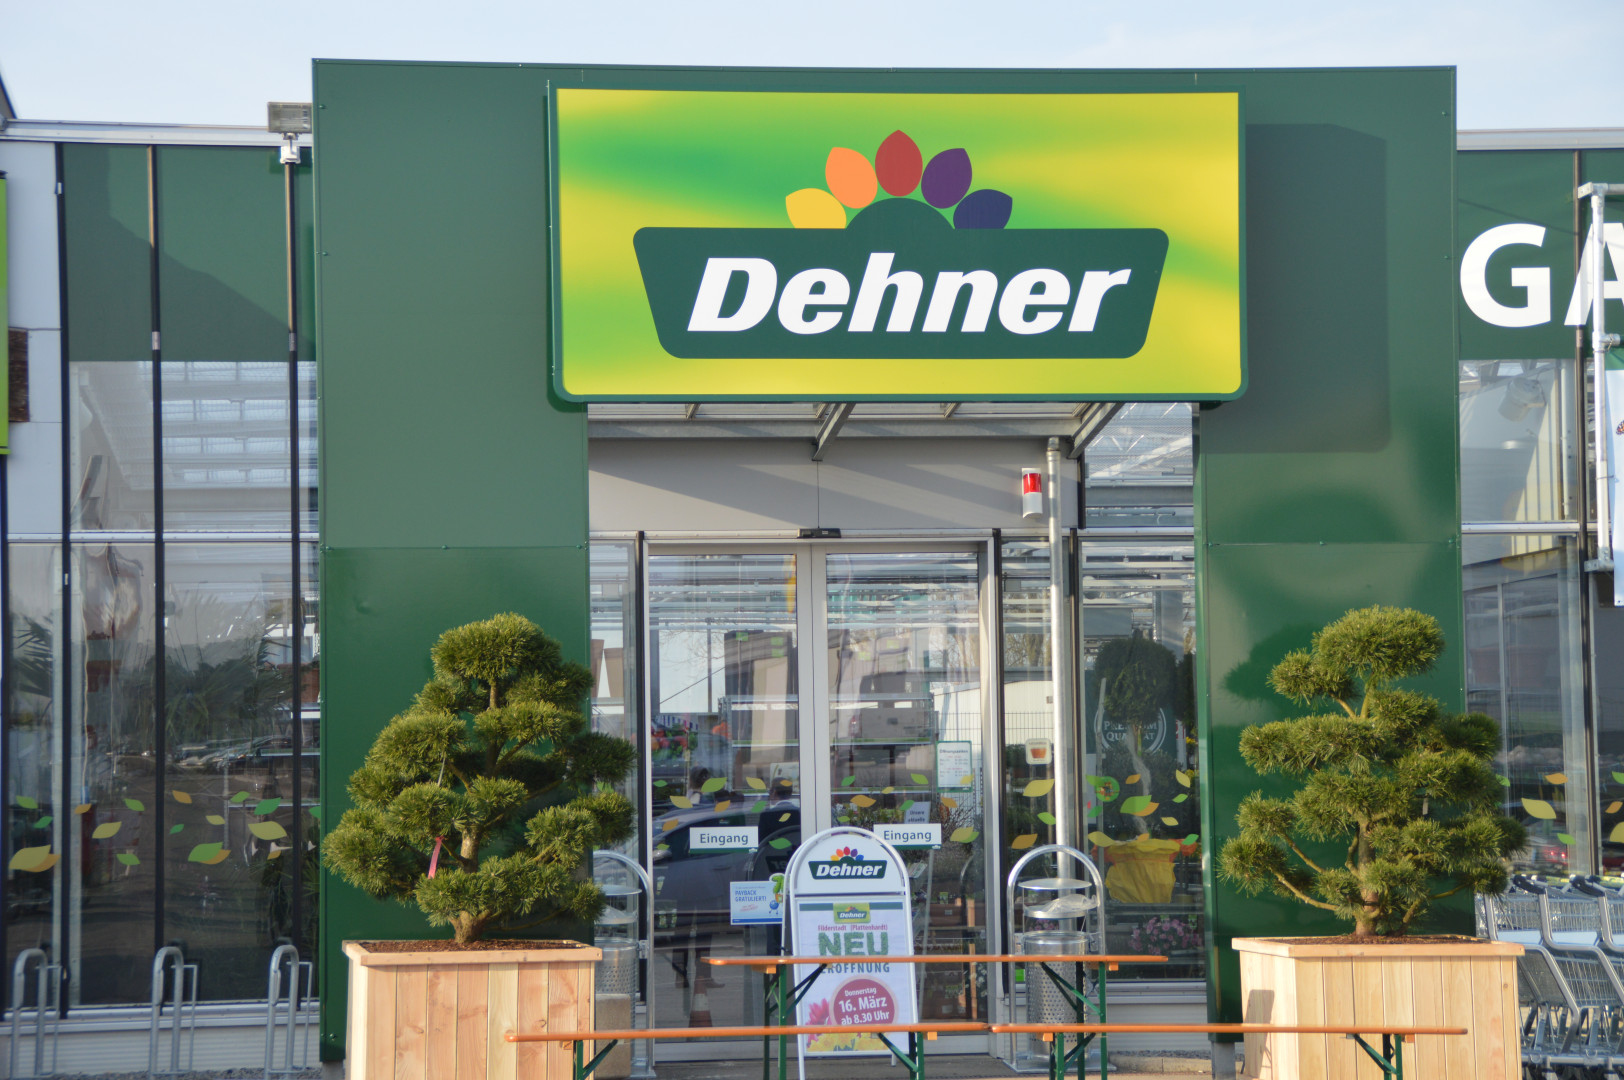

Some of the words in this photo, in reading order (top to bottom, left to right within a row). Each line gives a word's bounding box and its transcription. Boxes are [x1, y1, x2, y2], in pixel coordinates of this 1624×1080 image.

[687, 252, 1131, 334] Dehner
[699, 833, 749, 846] Eingang
[883, 830, 932, 843] Eingang
[816, 864, 883, 877] Dehner
[818, 931, 889, 957] NEU
[844, 987, 877, 997] Donnerstag
[838, 999, 857, 1013] 16.
[858, 995, 888, 1011] März
[841, 1014, 853, 1026] ab
[853, 1011, 873, 1025] 8.30
[873, 1009, 890, 1021] Uhr
